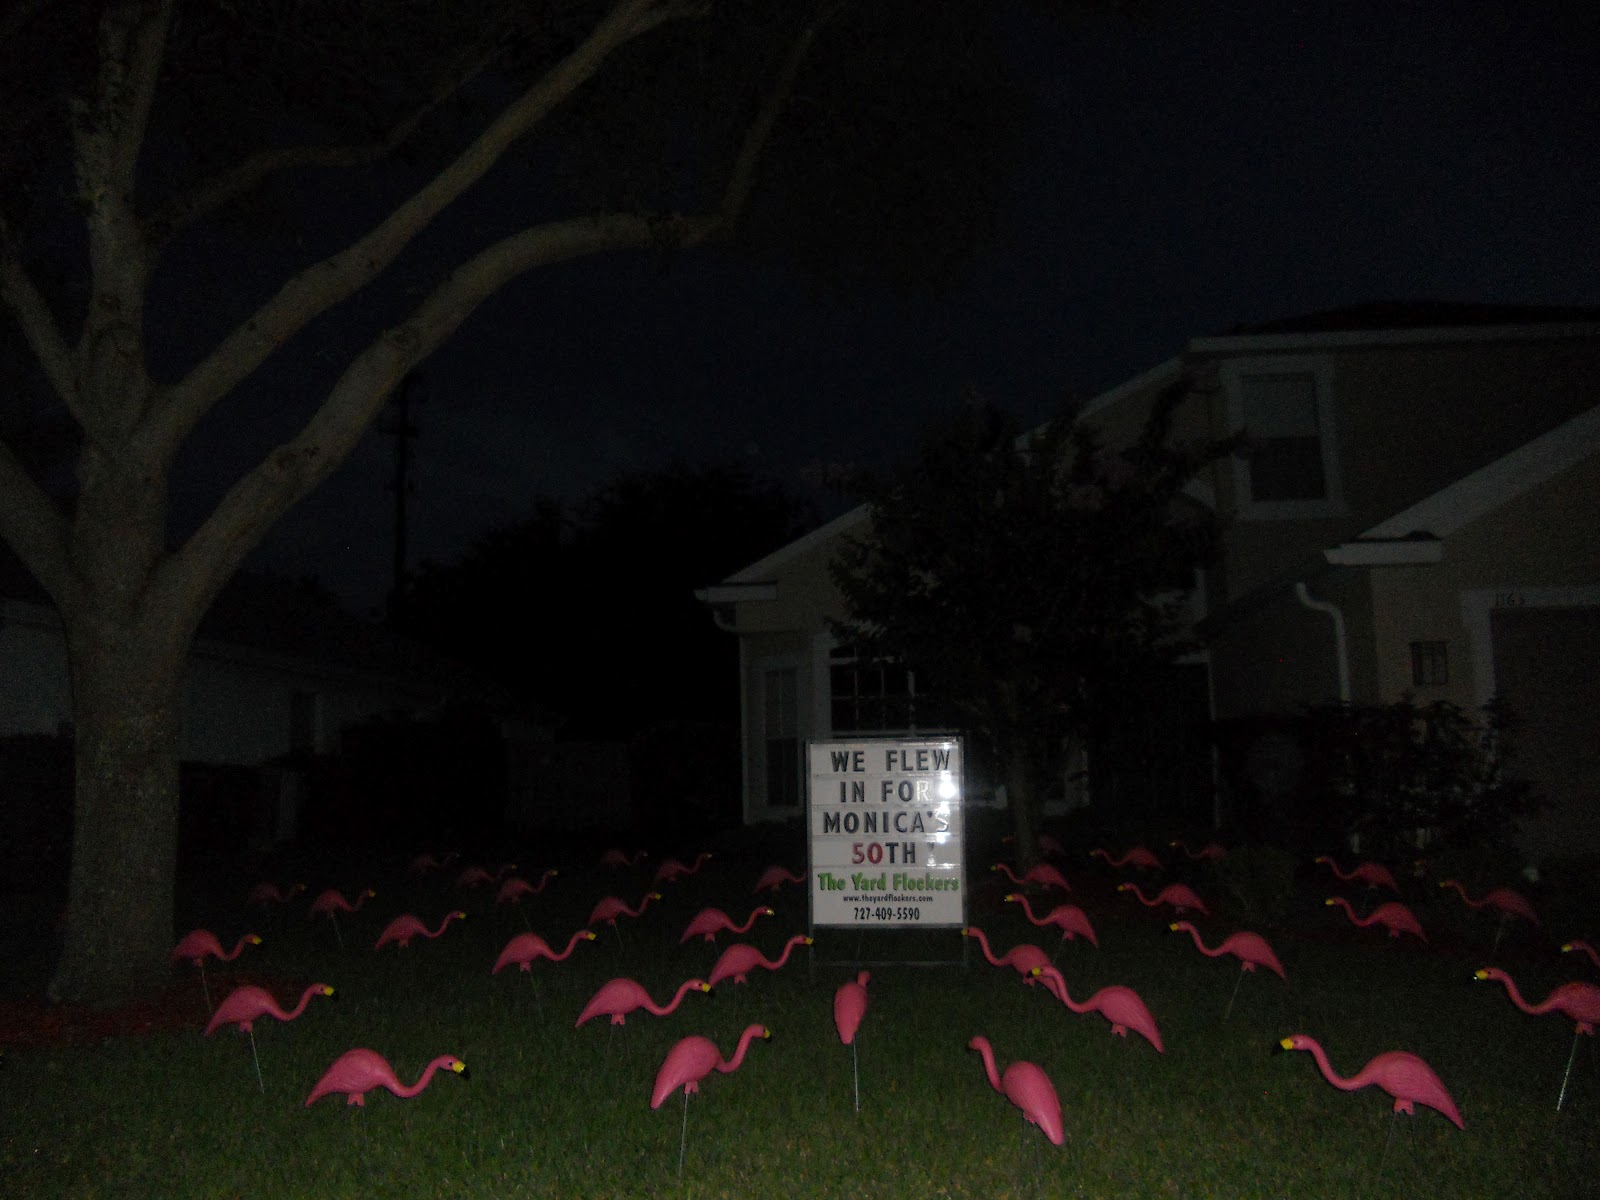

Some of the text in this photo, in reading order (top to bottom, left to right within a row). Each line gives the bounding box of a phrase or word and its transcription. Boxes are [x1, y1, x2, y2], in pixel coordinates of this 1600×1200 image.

[830, 749, 951, 773] WE FLEW
[840, 780, 932, 803] IN FOR
[823, 811, 949, 834] MONICA'S
[852, 842, 916, 864] 50TH
[818, 872, 959, 891] The Yard Flockers
[843, 894, 933, 903] www.theyardflockers.com
[854, 907, 920, 921] 727-409-5590
